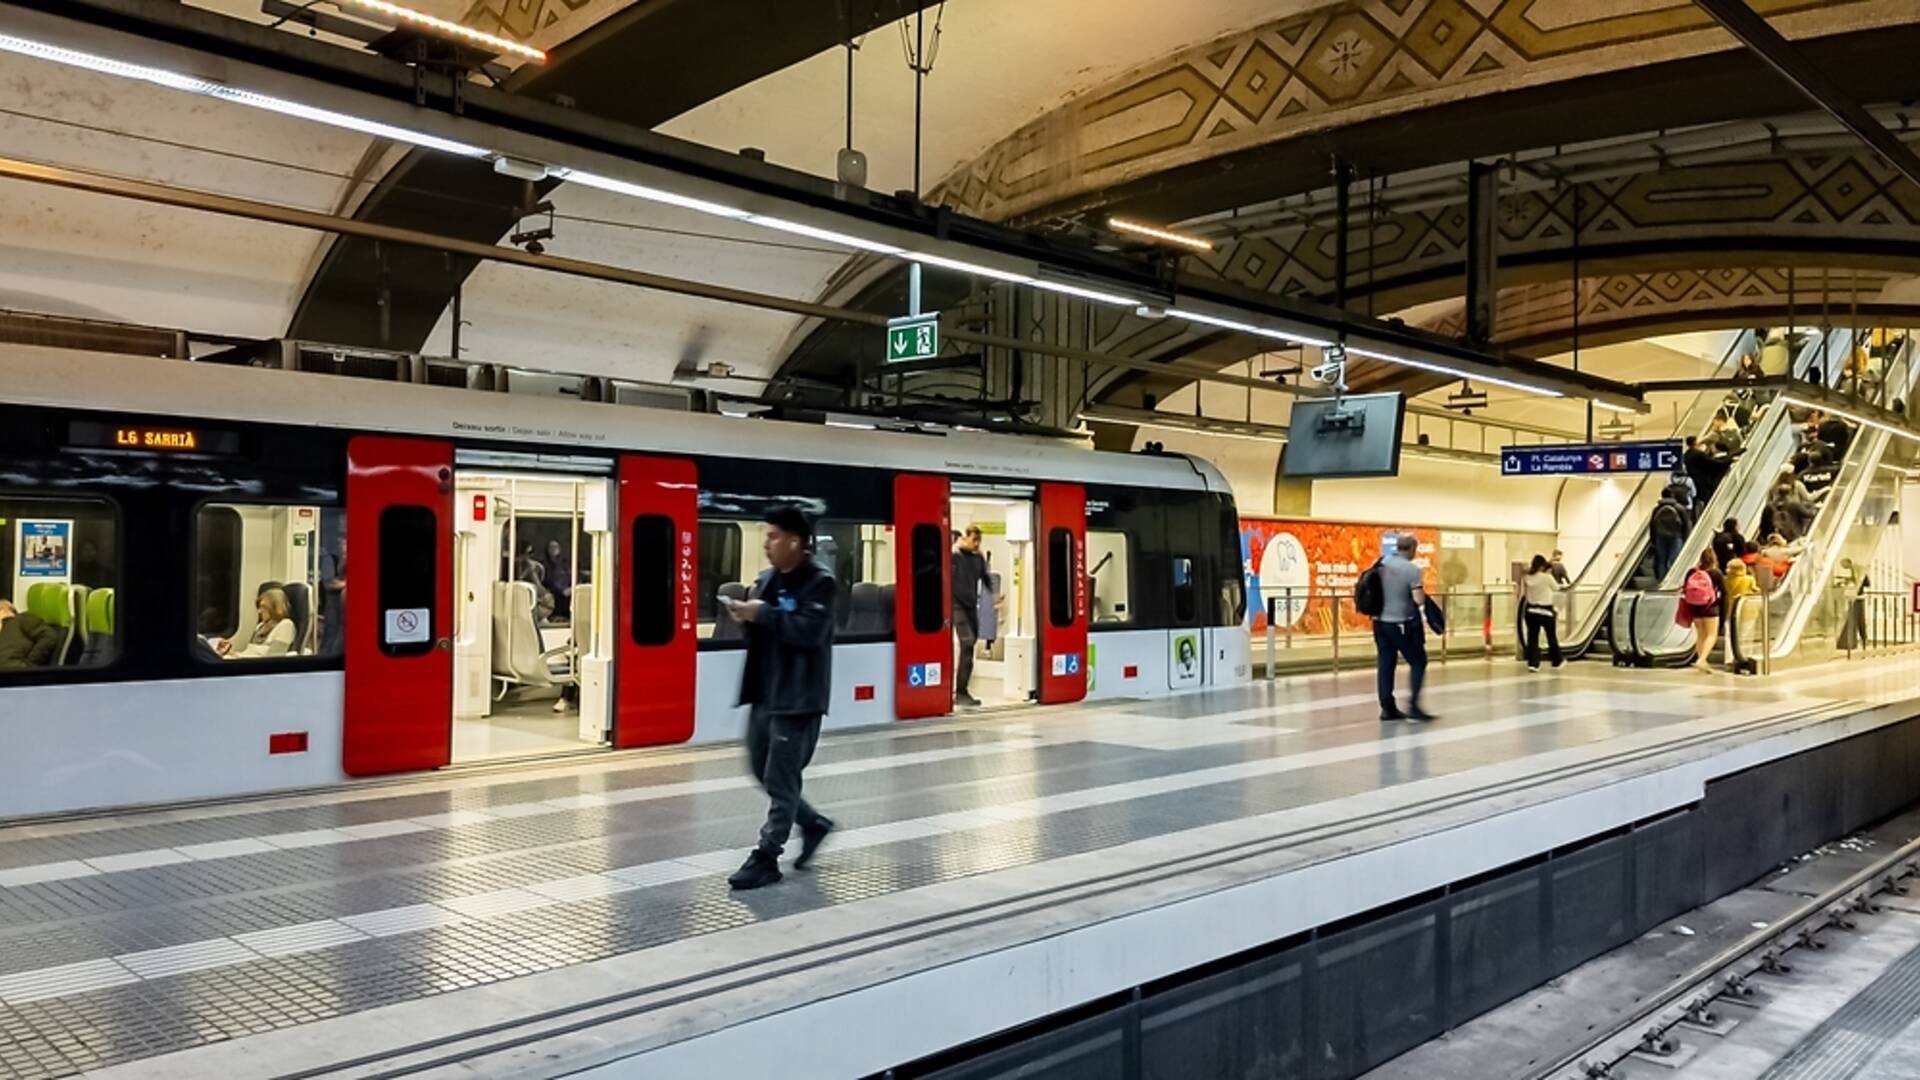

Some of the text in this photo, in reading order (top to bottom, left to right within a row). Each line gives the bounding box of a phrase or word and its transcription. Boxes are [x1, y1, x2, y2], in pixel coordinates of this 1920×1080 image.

[118, 430, 195, 448] L6 SARRIÀ
[1543, 454, 1582, 464] Catalunya
[1543, 463, 1573, 471] Rambla
